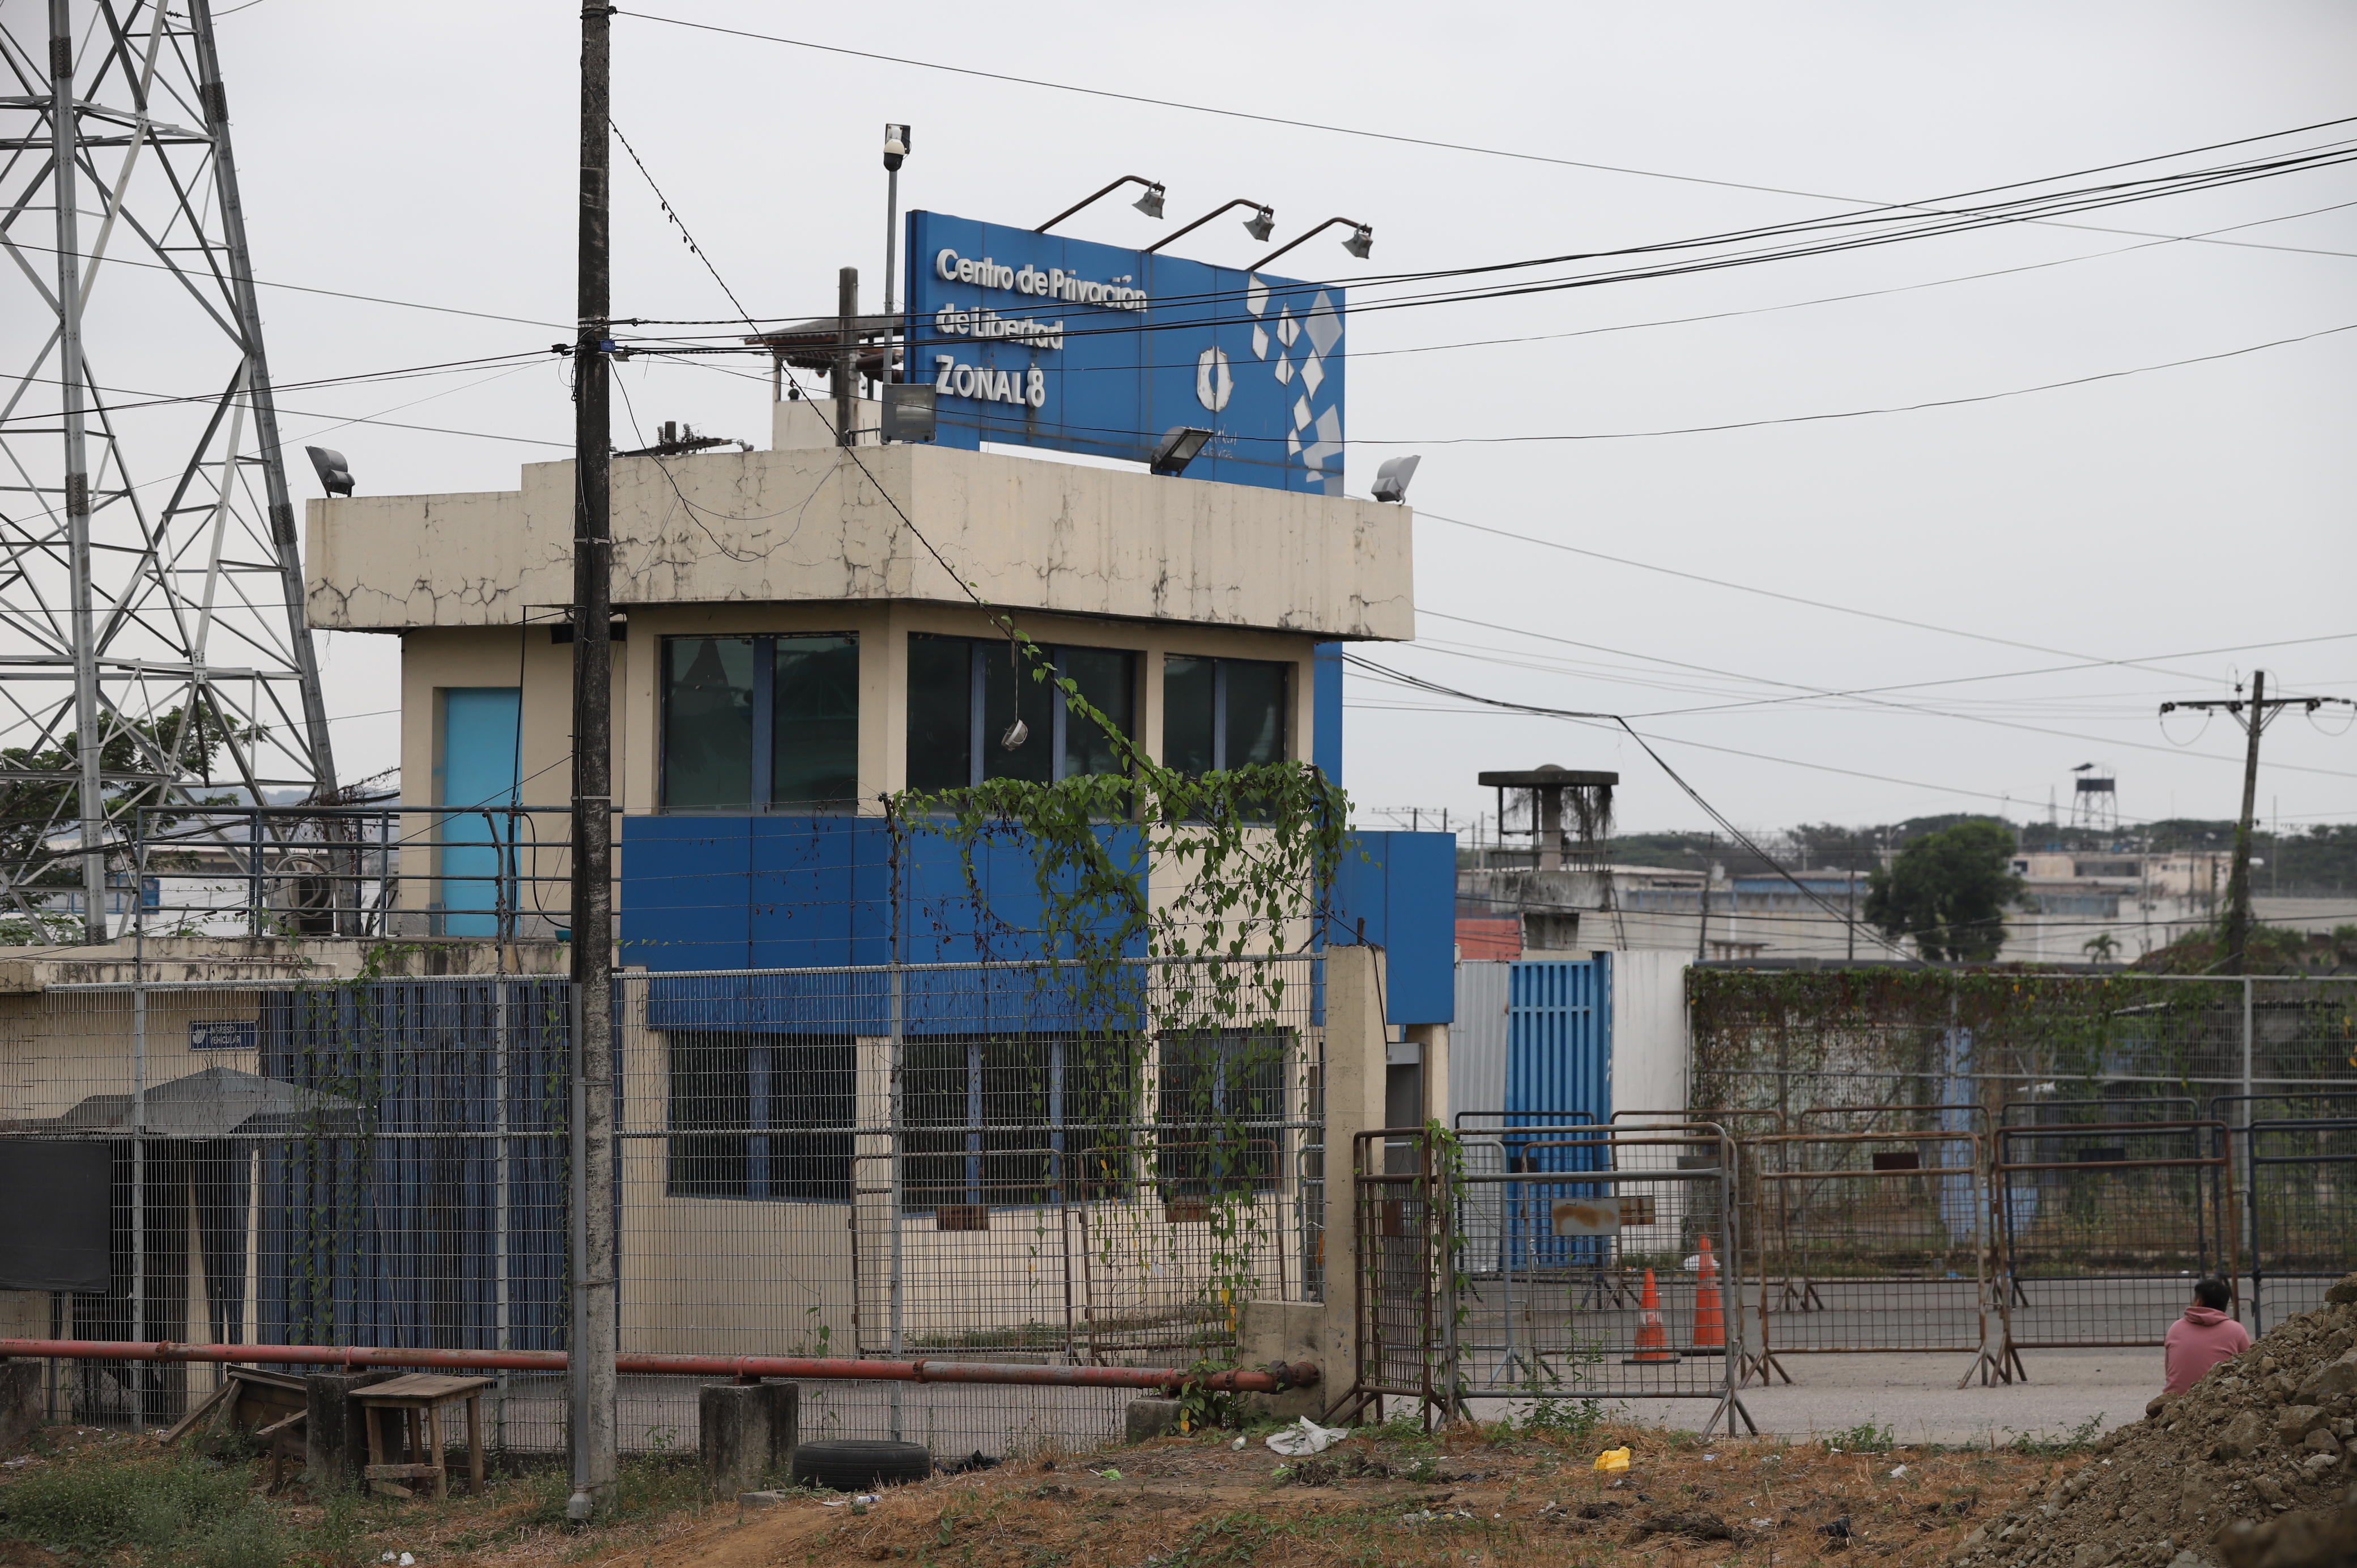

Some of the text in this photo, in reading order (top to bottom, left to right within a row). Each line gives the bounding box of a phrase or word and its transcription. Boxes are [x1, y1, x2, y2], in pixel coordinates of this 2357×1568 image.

[936, 248, 1147, 313] Centro de Privación
[936, 303, 1063, 350] de Libertad
[935, 354, 1045, 408] ZONAL 8
[209, 1025, 235, 1034] INGRESO
[209, 1036, 240, 1044] VEHICULAR
